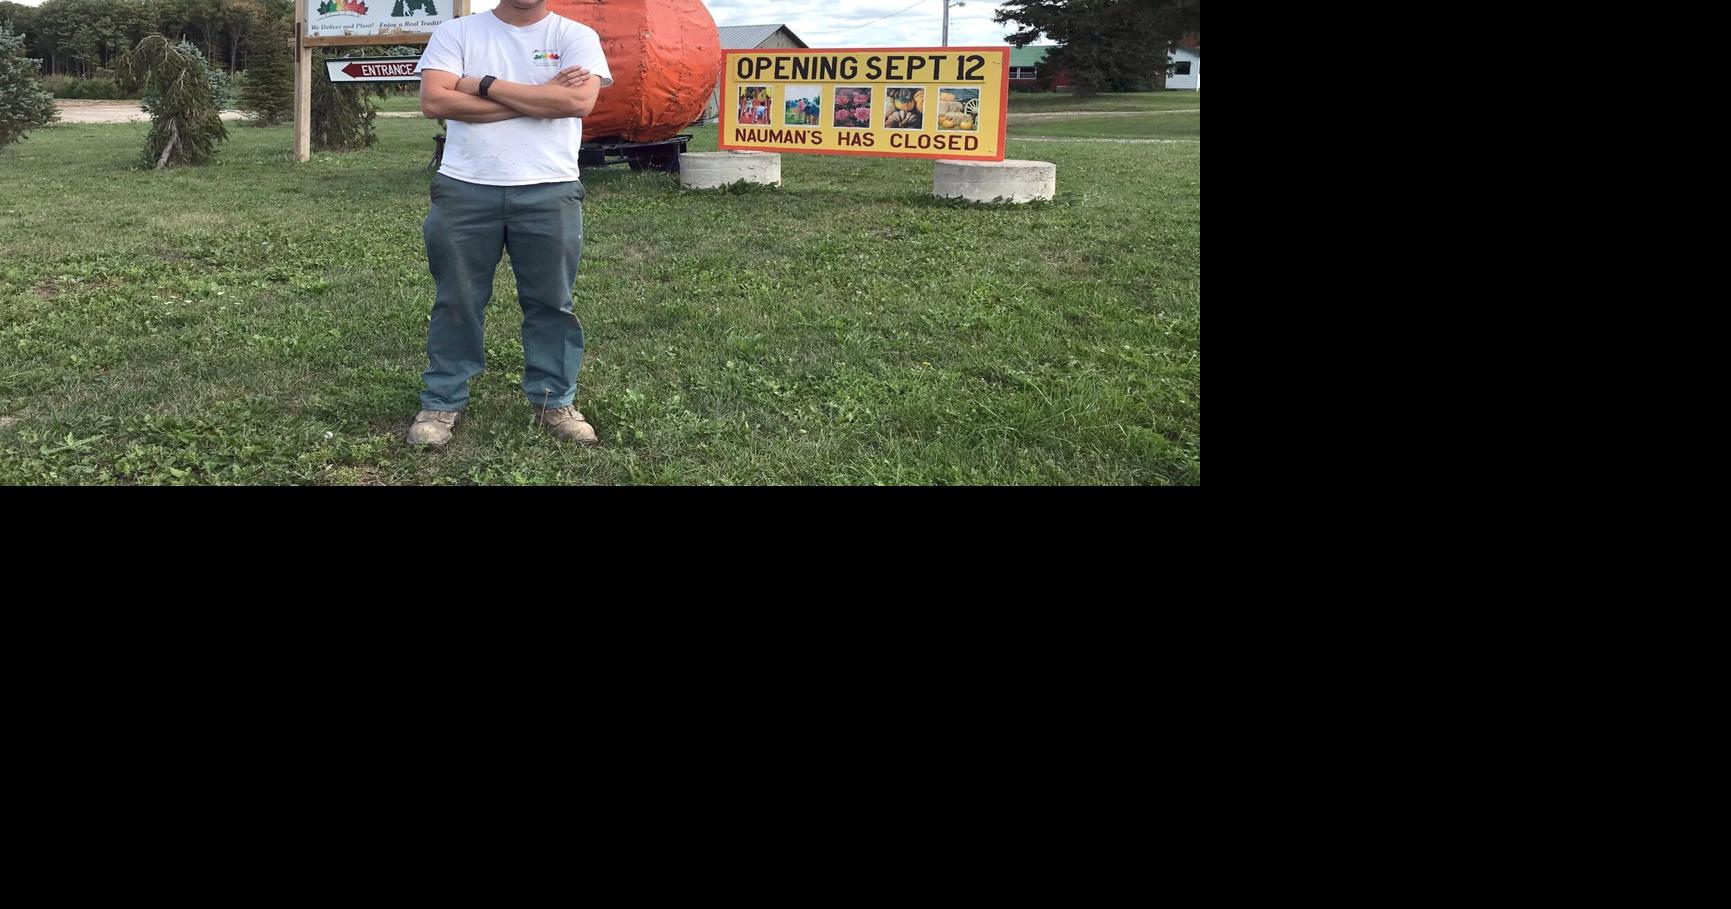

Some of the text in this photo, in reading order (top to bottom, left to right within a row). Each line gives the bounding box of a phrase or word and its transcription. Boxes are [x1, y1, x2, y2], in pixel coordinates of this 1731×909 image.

[361, 64, 414, 76] ENTRANCE
[737, 55, 985, 80] OPENING SEPT 12
[735, 128, 978, 151] NAUMAN'S HAS CLOSED
